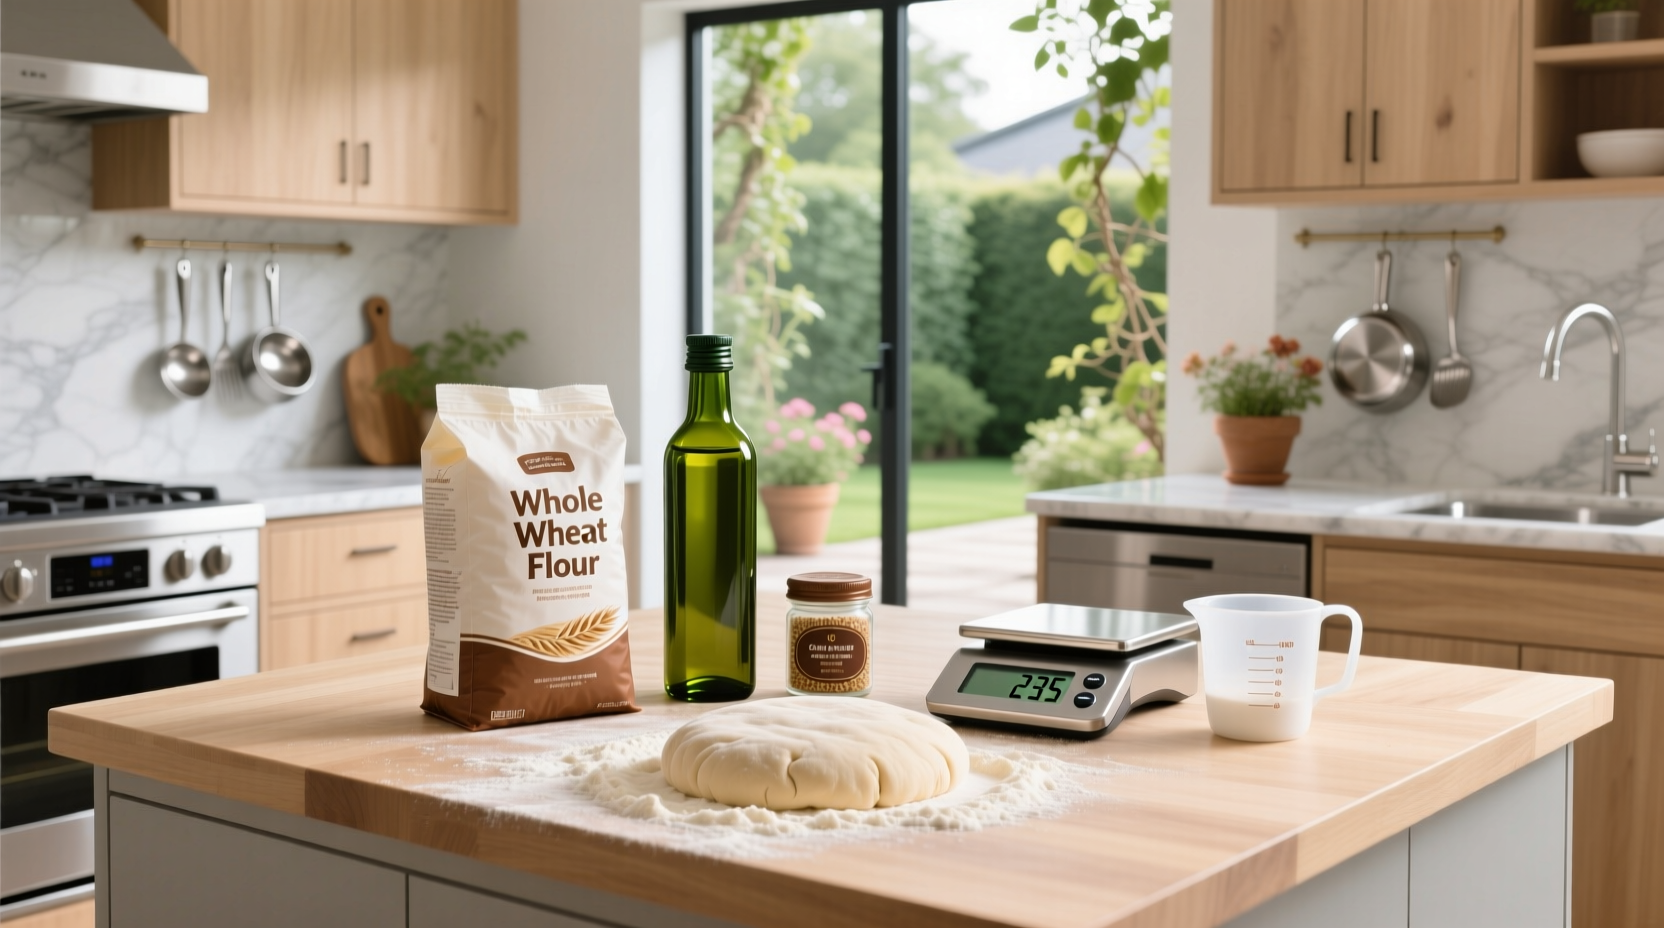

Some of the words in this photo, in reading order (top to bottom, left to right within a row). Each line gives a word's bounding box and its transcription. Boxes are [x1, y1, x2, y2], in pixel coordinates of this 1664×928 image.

[510, 485, 603, 517] Whole
[513, 517, 607, 548] Wheat
[528, 551, 600, 580] Flour
[1009, 674, 1067, 703] 235
